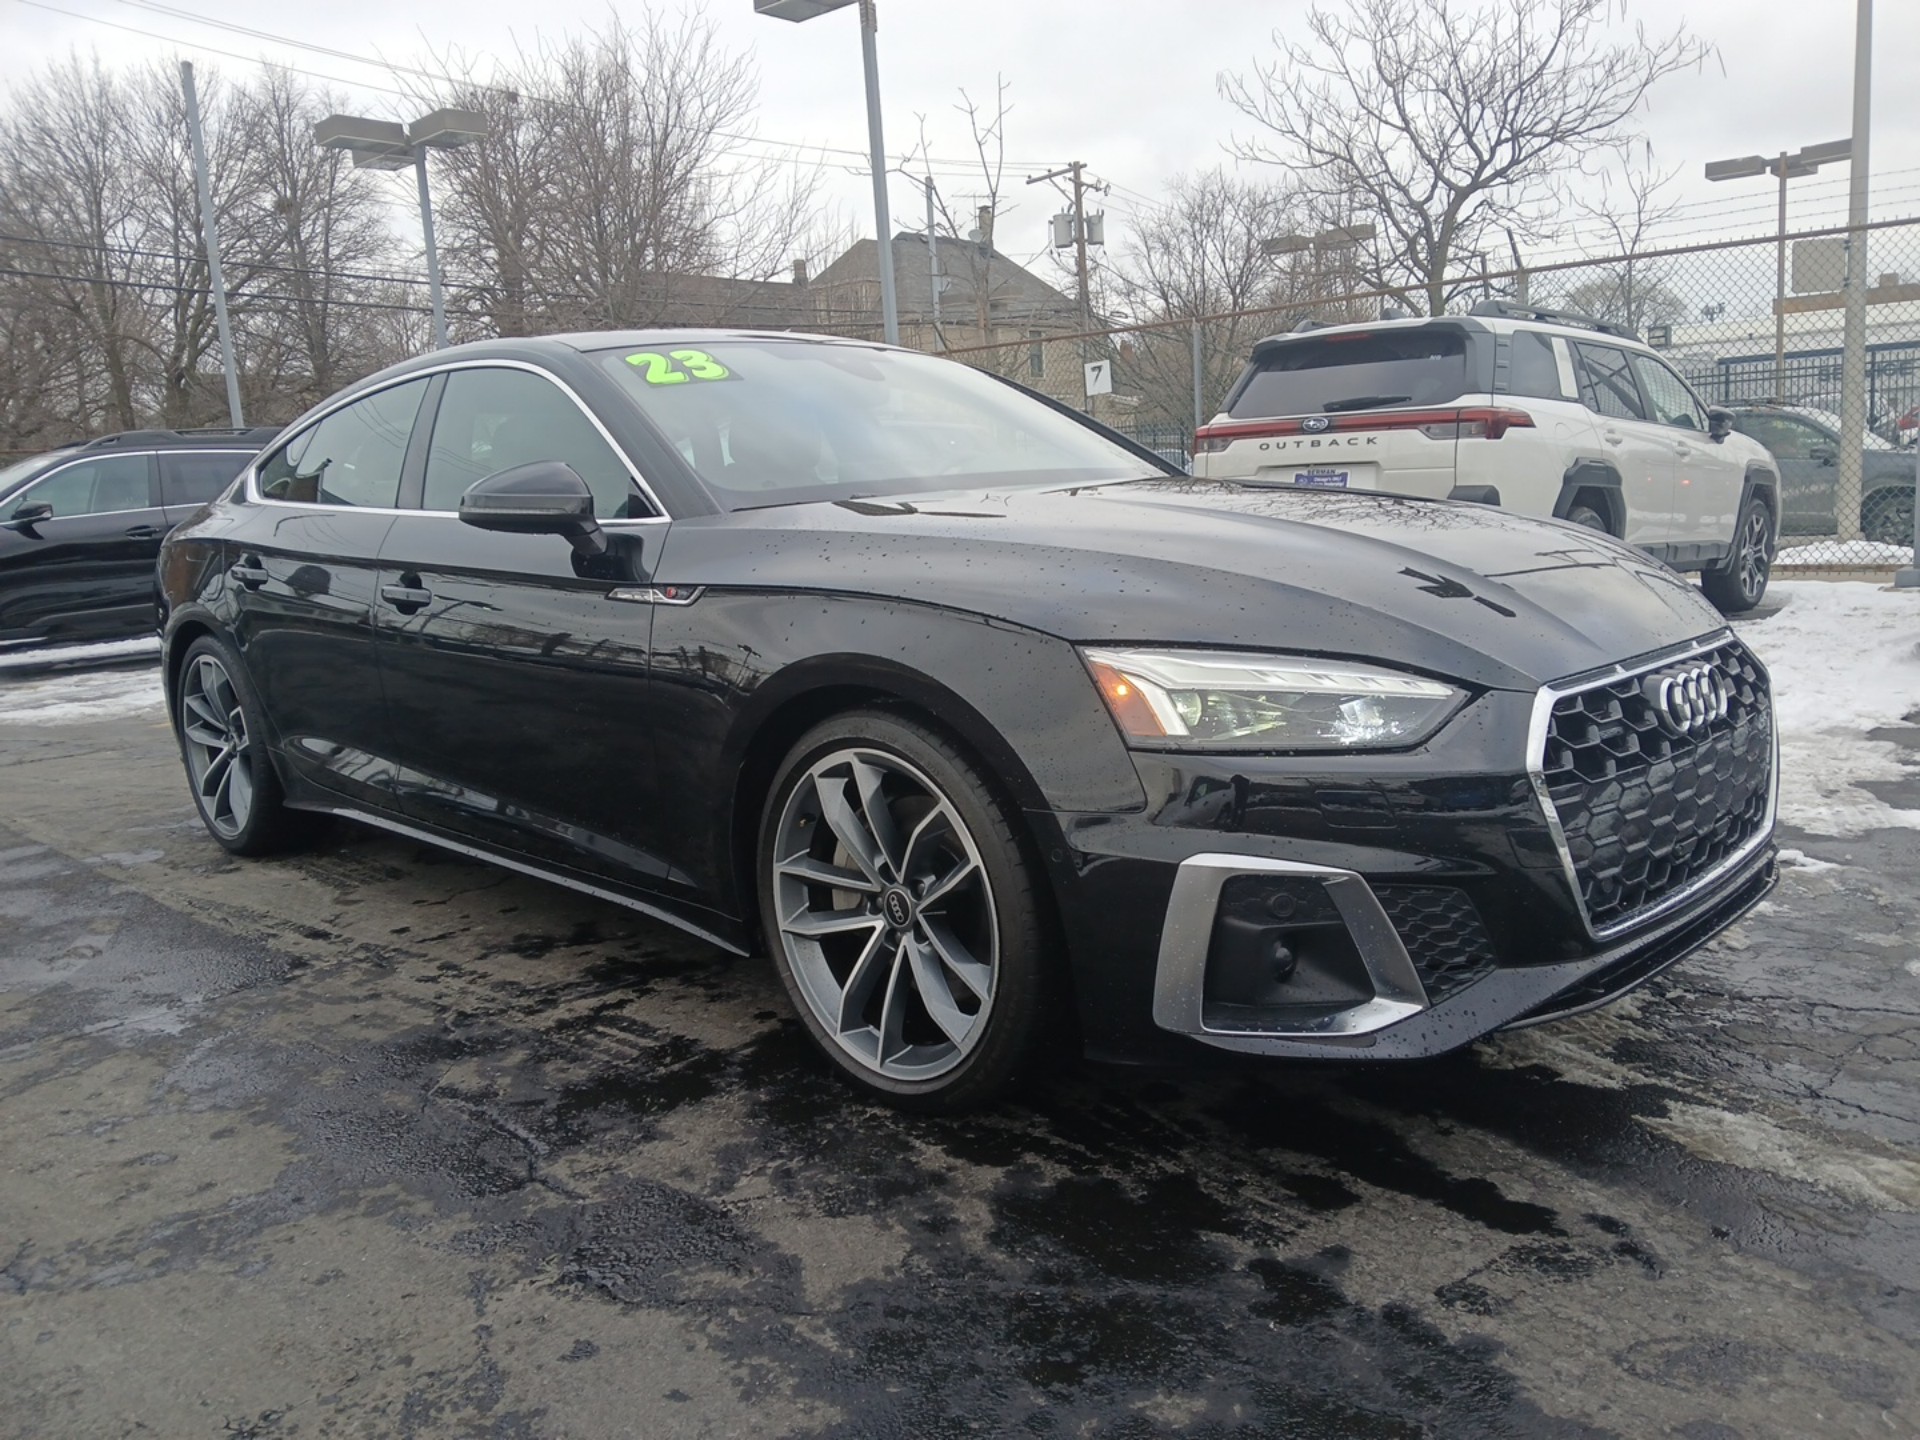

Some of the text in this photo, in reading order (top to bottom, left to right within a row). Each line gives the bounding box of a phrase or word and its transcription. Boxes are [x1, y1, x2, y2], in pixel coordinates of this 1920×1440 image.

[625, 350, 729, 384] 23
[1090, 365, 1103, 386] 7
[1819, 361, 1913, 382] SEICE
[1259, 436, 1378, 451] OUTBACK
